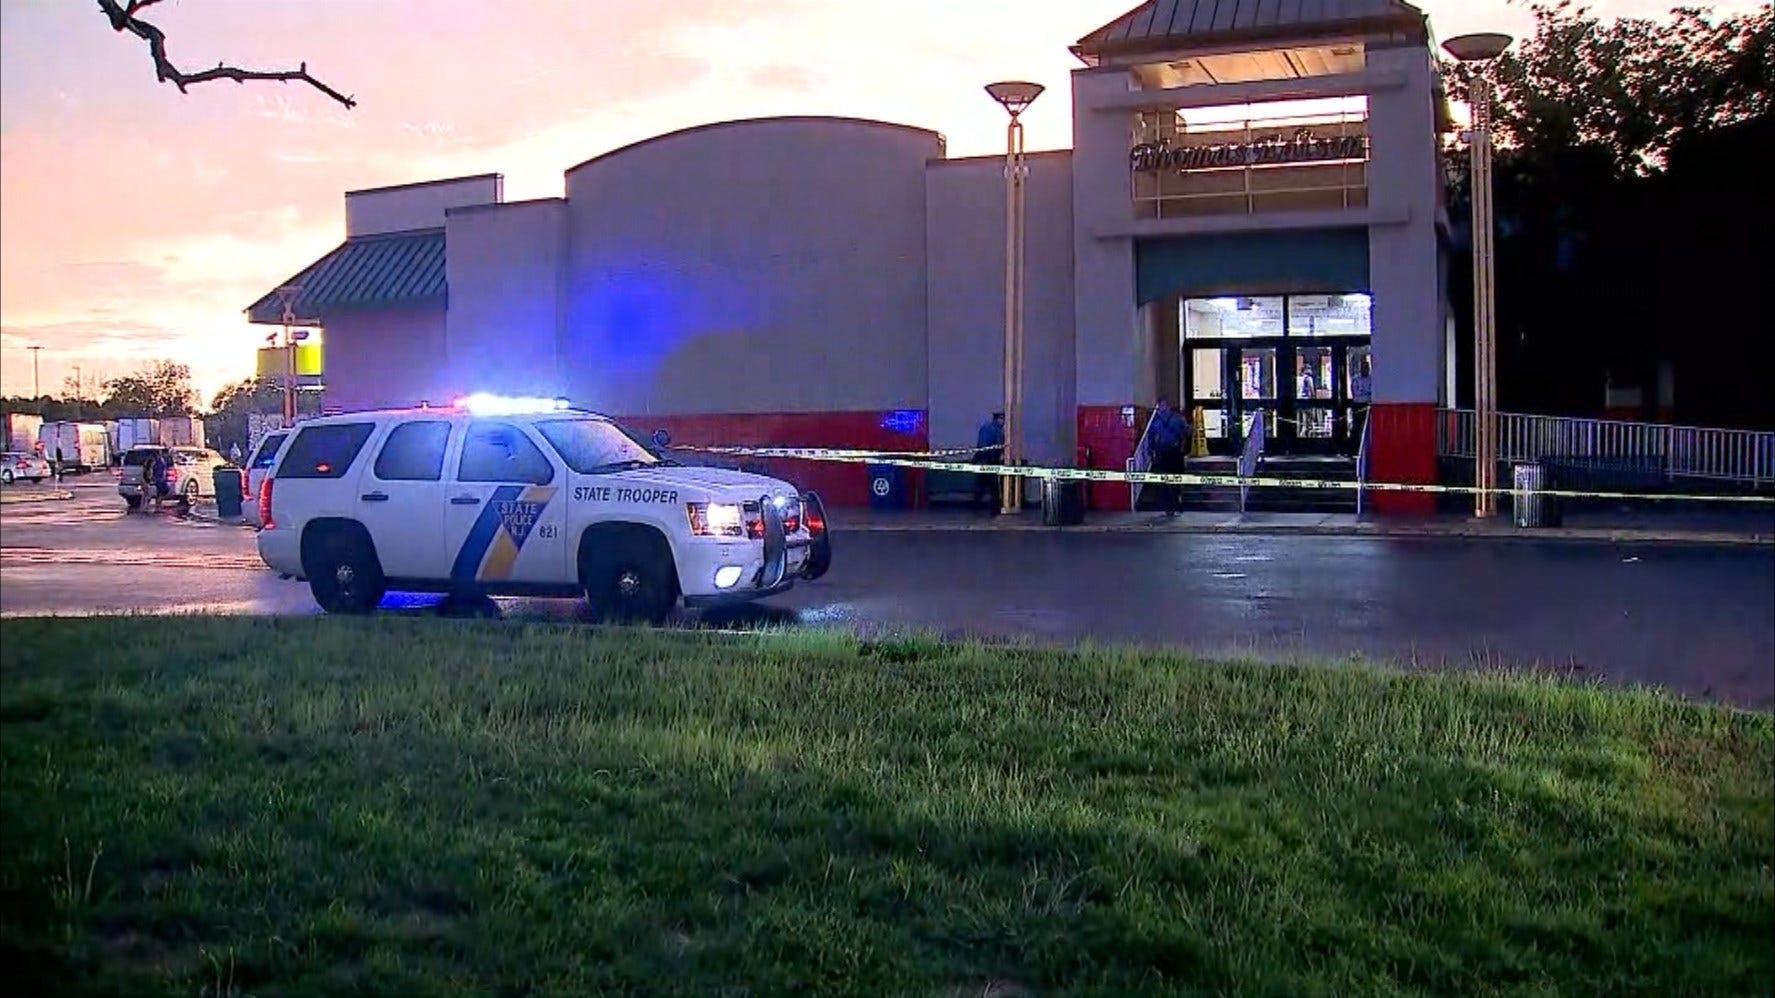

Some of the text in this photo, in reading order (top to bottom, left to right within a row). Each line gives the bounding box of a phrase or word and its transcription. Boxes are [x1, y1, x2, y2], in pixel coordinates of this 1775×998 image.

[574, 486, 679, 505] STATE TROOPER
[500, 503, 537, 515] STATE
[503, 515, 533, 526] POLICE
[539, 525, 558, 539] 821
